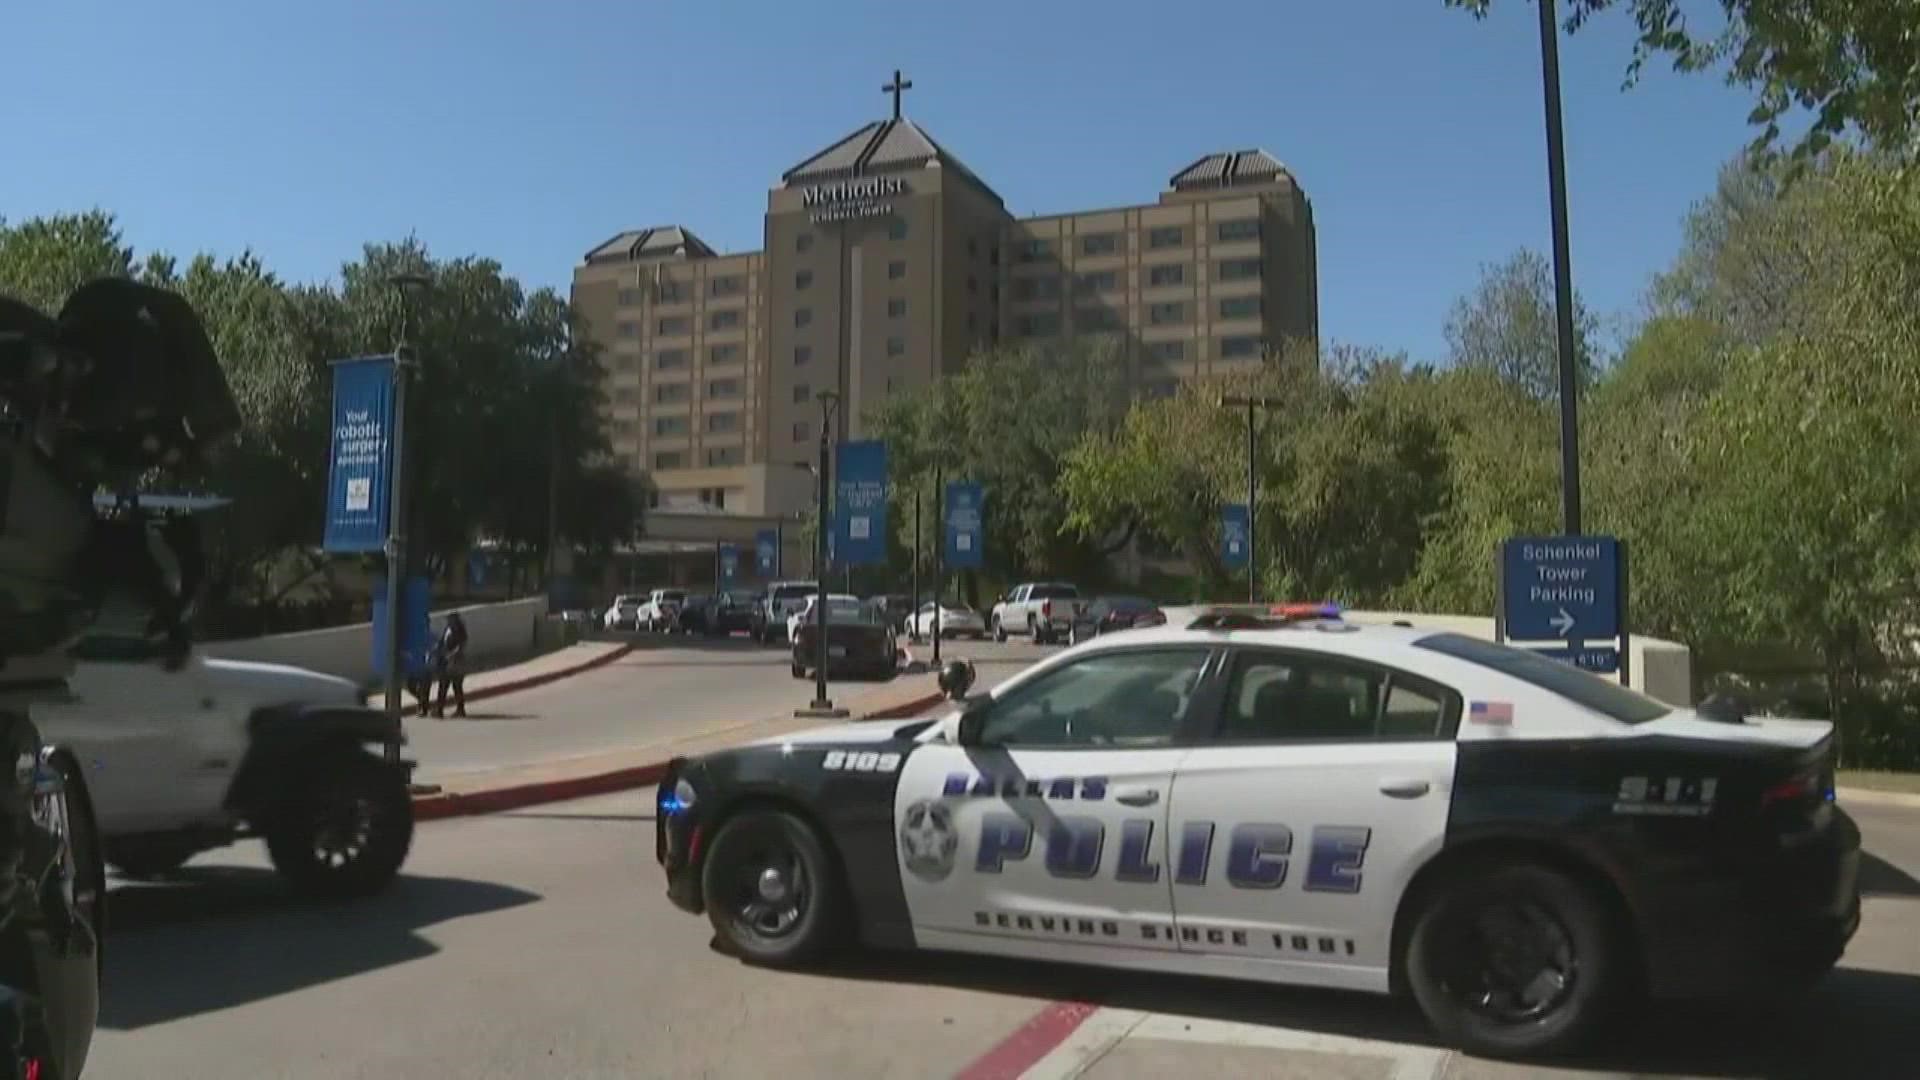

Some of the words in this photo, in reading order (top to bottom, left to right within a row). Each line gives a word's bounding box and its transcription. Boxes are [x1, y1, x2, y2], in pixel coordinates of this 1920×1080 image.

[802, 176, 904, 206] Methodist
[345, 408, 368, 422] Your
[336, 421, 381, 440] robotic
[1522, 543, 1600, 560] Schenkel
[1537, 565, 1587, 581] Tower
[1530, 585, 1595, 605] Parking
[822, 750, 902, 772] 8109
[942, 772, 1109, 801] DALLAS
[974, 812, 1373, 894] POLICE
[974, 911, 1119, 937] SERVING
[1140, 924, 1248, 947] SINCE
